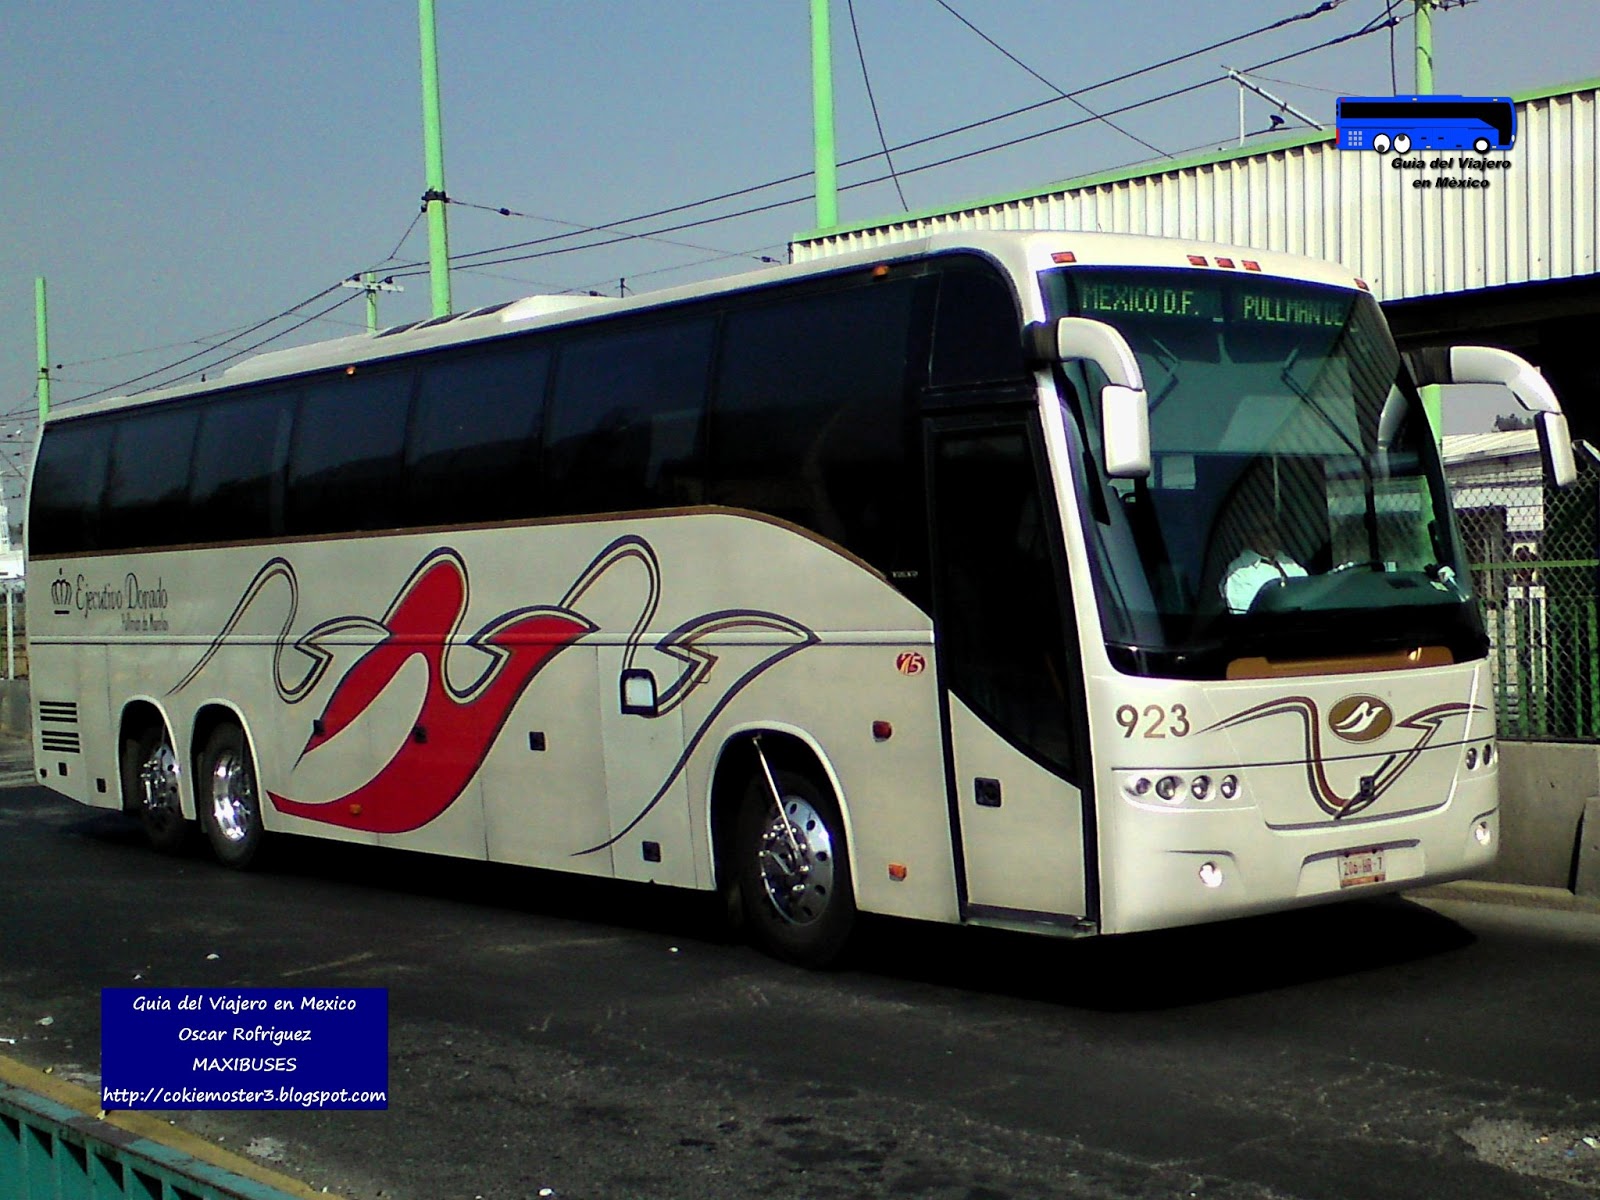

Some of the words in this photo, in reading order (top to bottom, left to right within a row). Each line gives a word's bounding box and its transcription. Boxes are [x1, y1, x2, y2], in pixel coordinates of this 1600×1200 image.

[1082, 284, 1157, 313] MEXICO
[1244, 296, 1320, 325] PULLMAN
[75, 573, 122, 619] Ejecutivo
[125, 572, 168, 609] Dorado
[1116, 703, 1190, 739] 923
